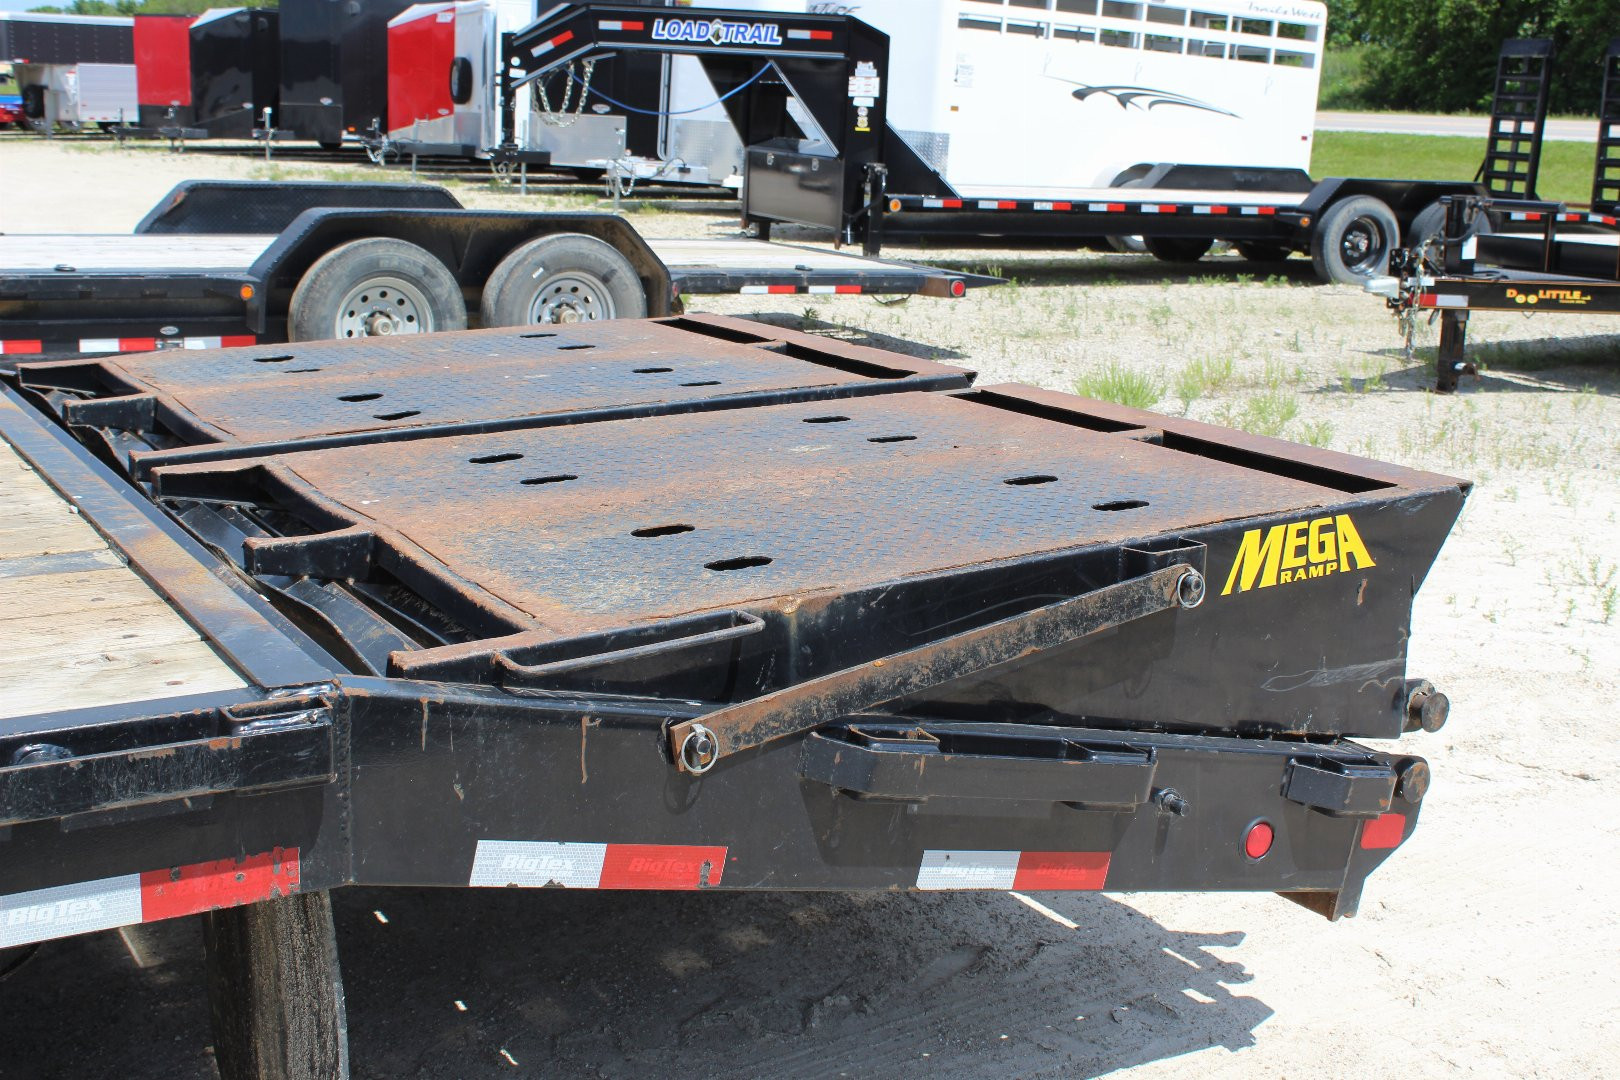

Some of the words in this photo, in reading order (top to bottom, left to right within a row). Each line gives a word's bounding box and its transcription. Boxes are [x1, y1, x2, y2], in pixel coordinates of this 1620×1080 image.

[653, 19, 711, 40] LOAD
[721, 22, 782, 44] TRAIL
[1221, 514, 1377, 596] MEGA
[1280, 561, 1338, 584] RAMP
